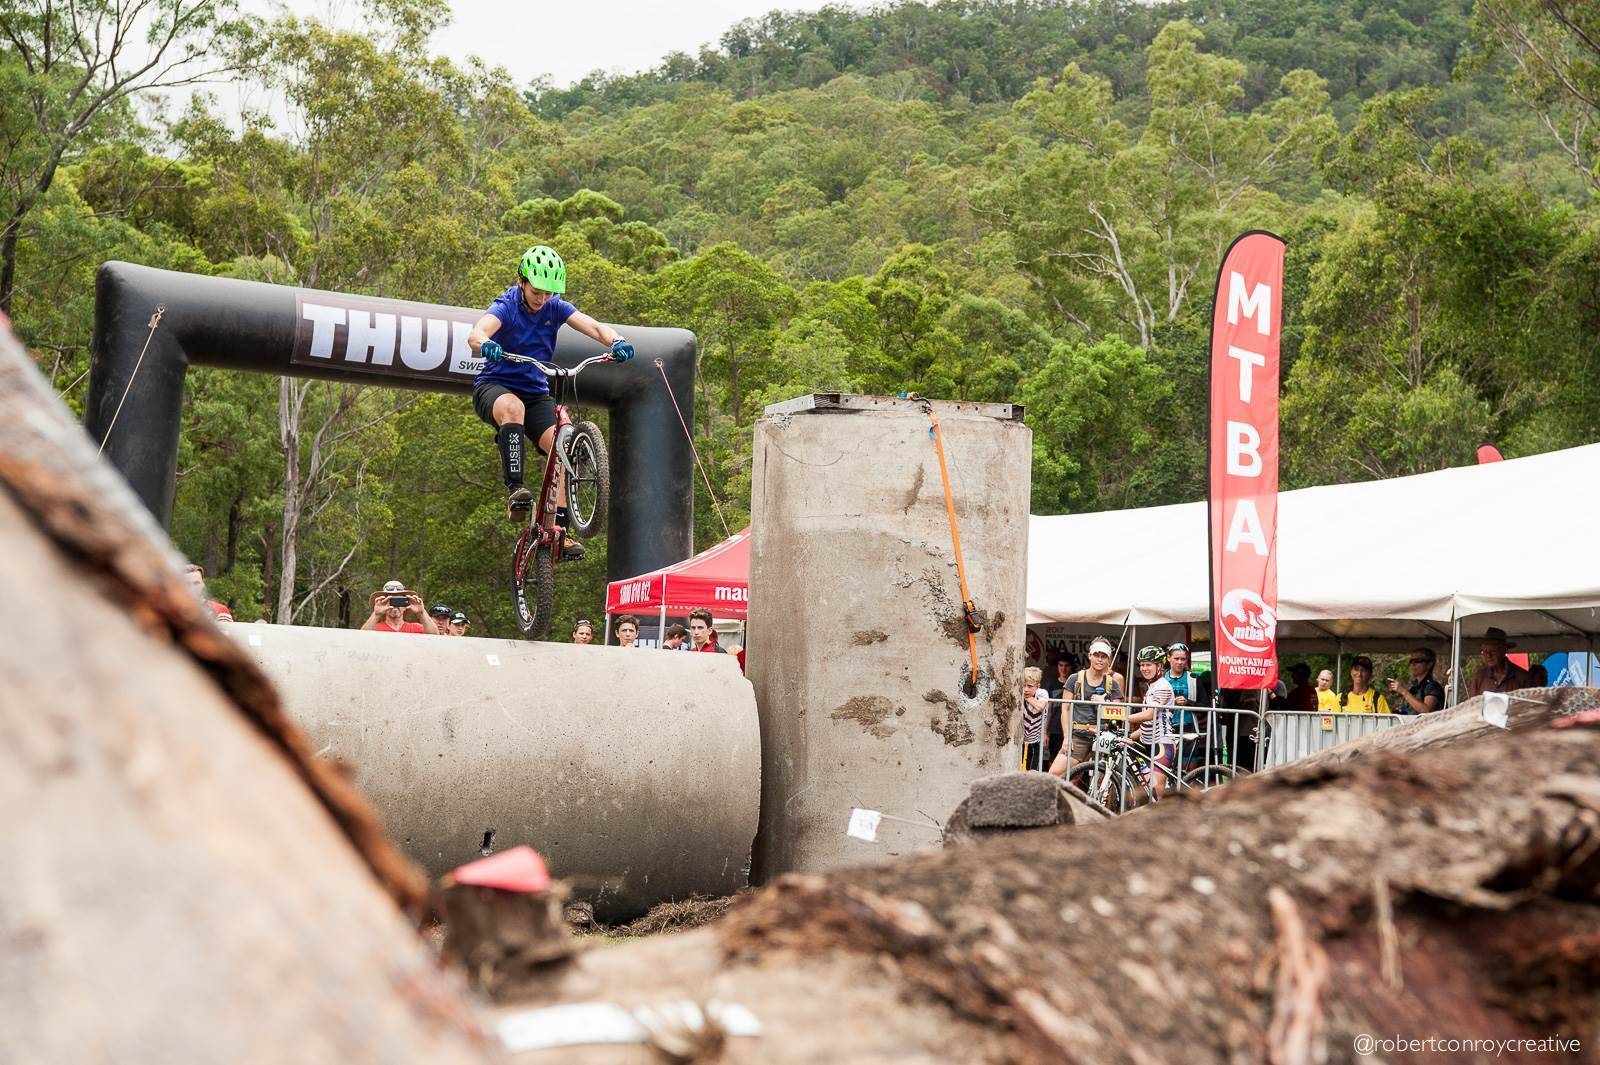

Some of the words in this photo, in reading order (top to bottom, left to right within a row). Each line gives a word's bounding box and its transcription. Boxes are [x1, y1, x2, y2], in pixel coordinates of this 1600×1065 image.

[459, 361, 485, 371] SWE
[1225, 270, 1272, 556] MTBA
[1219, 655, 1263, 666] MOUNTAIN
